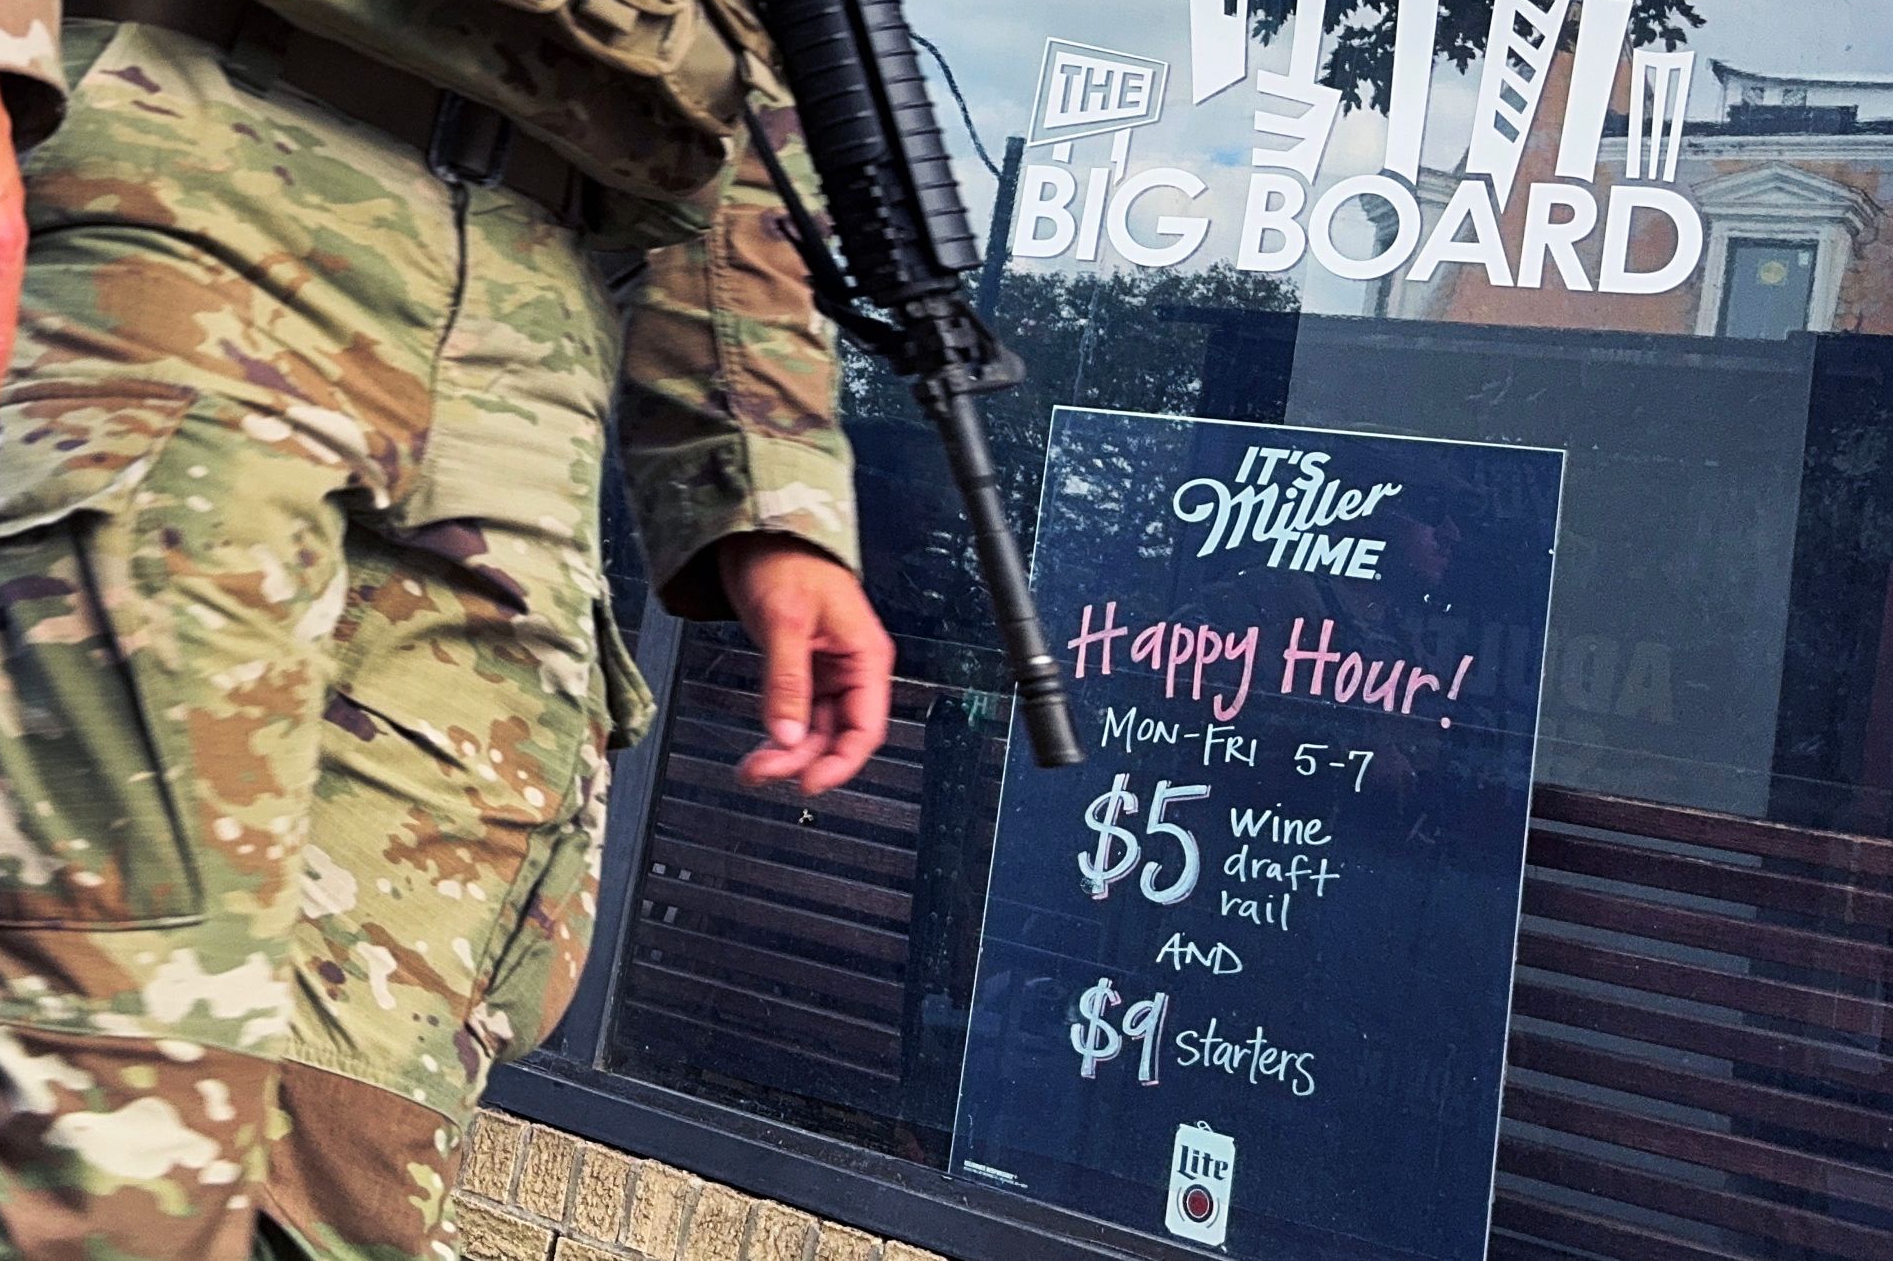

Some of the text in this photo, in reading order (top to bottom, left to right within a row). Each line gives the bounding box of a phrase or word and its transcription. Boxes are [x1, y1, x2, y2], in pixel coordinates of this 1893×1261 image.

[1059, 63, 1145, 114] THE
[1011, 165, 1704, 295] BIG BOARD
[1234, 446, 1331, 490] IT'S
[1173, 478, 1402, 558] Miller
[1266, 531, 1387, 580] TIME
[1067, 601, 1474, 729] Happy Hour!
[1294, 743, 1374, 792] 5-7
[1077, 773, 1332, 905] $5 wine
[1223, 844, 1340, 897] draft
[1221, 890, 1290, 931] rail
[1156, 932, 1243, 975] AND
[1070, 977, 1315, 1096] $9 starters
[1177, 1144, 1229, 1181] Lite
